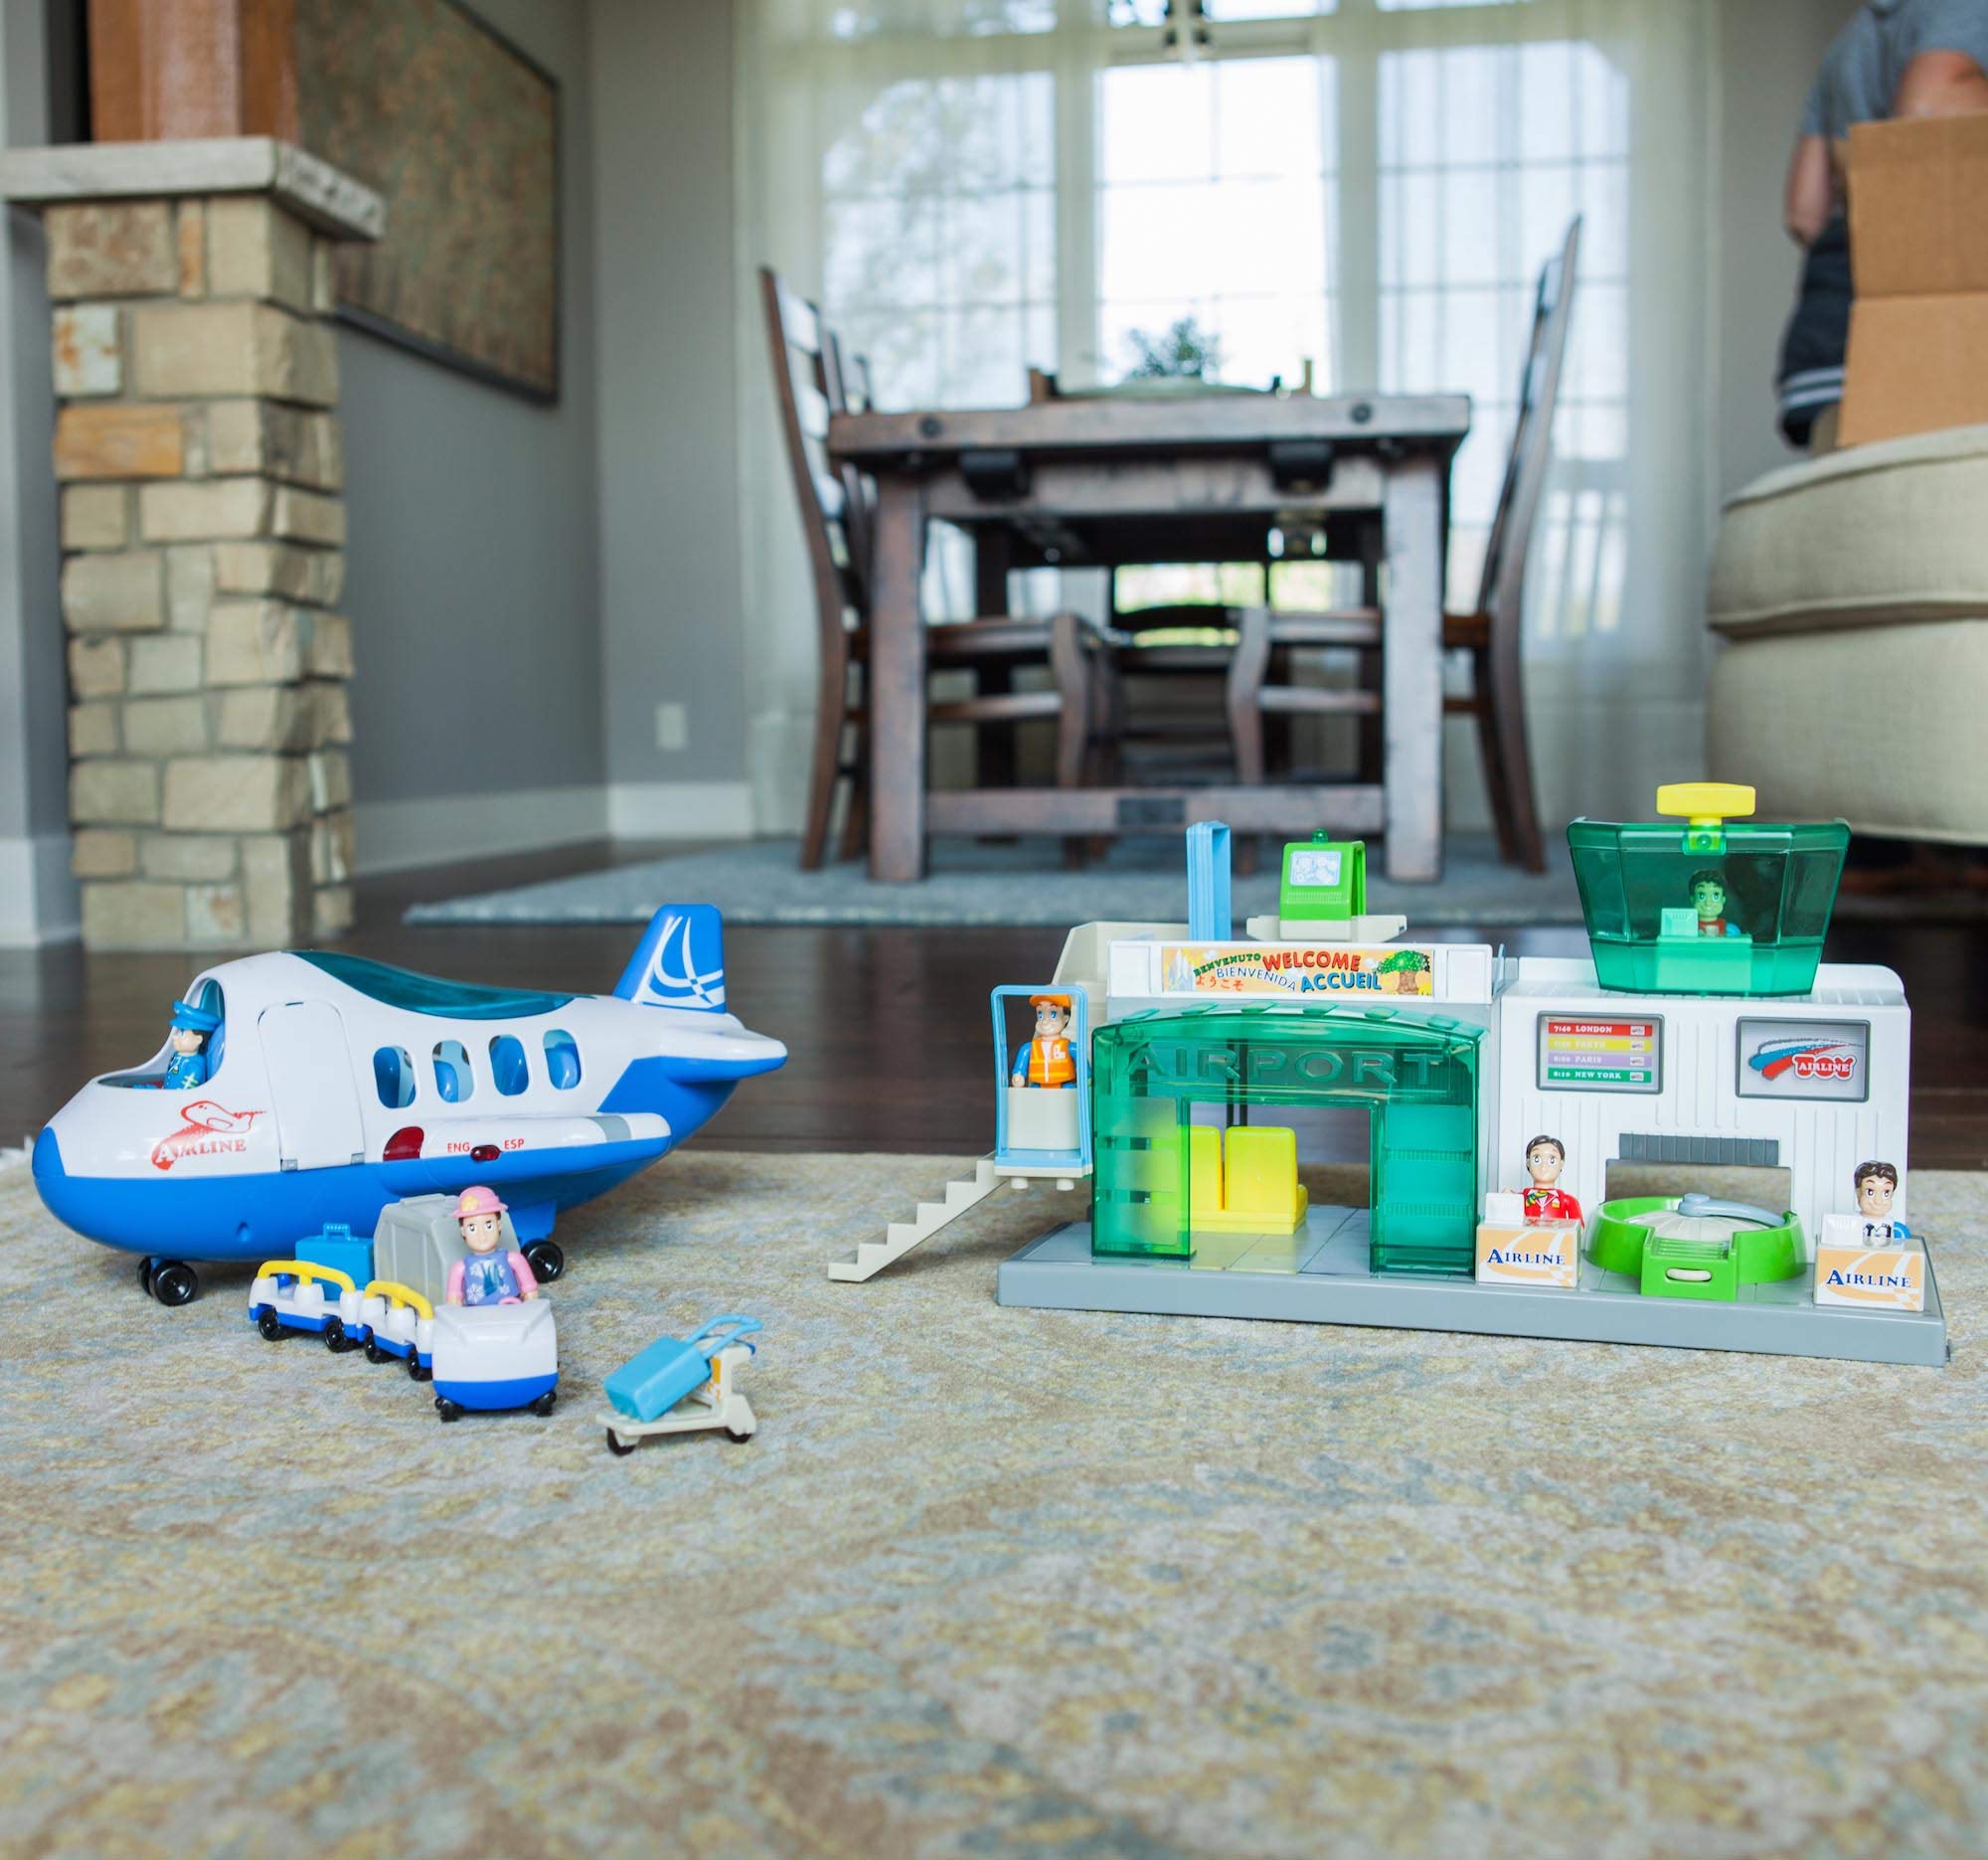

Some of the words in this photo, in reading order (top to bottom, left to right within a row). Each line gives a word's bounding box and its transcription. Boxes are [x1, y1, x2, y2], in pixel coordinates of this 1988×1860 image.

[1193, 952, 1261, 977] BENVENUTO
[1262, 950, 1362, 971] WELCOME
[1195, 974, 1243, 991] ようこそ
[1216, 966, 1296, 991] BIENVENIDA
[1300, 970, 1383, 993] ACCUEIL
[1574, 1025, 1612, 1034] LONDON
[1124, 1041, 1444, 1086] AIRPORT
[1798, 1062, 1850, 1072] AIRLINE
[1574, 1071, 1596, 1080] NEW
[1596, 1072, 1622, 1081] YORK
[155, 1138, 248, 1163] AIRLINE
[446, 1141, 471, 1153] ENG
[503, 1138, 525, 1150] ESP
[1487, 1249, 1567, 1266] AIRLINE
[1826, 1268, 1911, 1288] AIRLINE
